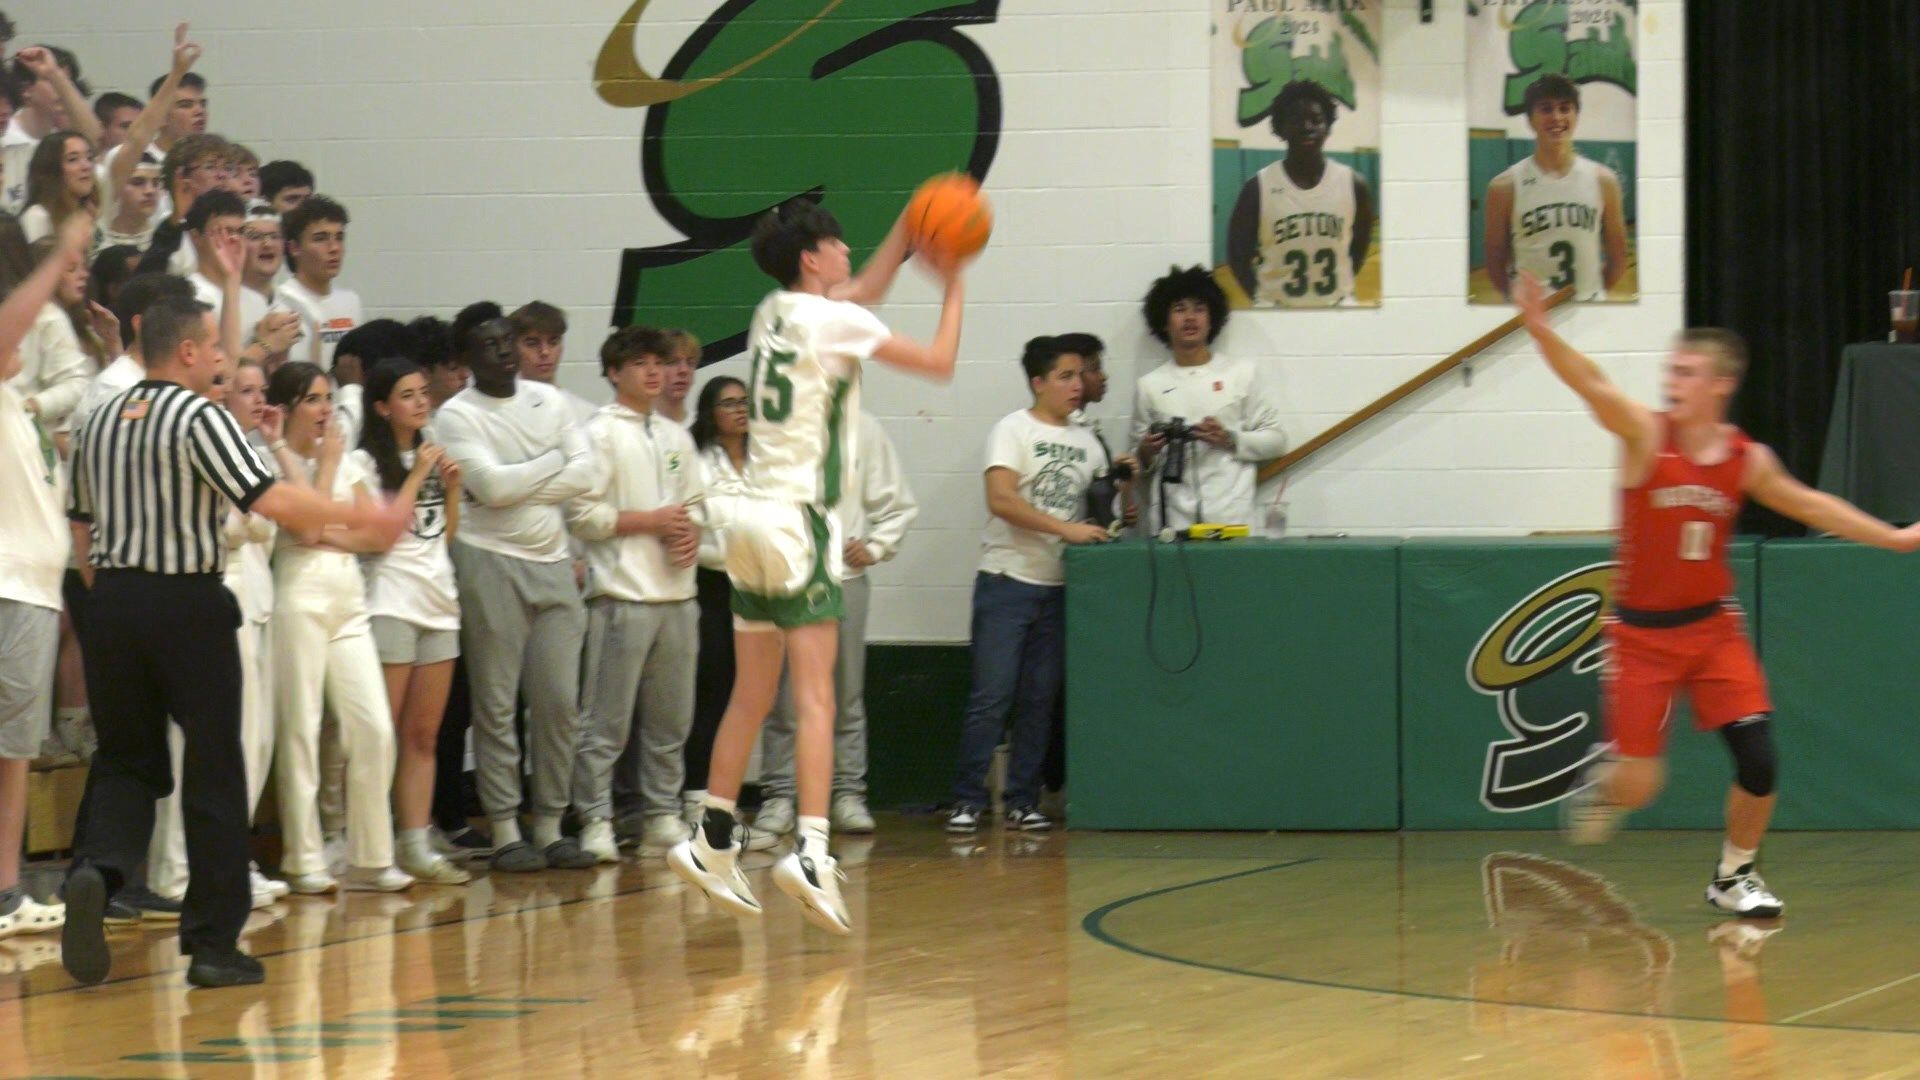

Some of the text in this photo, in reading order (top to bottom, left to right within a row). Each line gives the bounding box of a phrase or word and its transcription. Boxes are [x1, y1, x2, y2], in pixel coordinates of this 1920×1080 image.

[1274, 211, 1343, 244] SETON
[1521, 202, 1597, 236] SETON
[1283, 249, 1337, 297] 33
[1549, 240, 1575, 291] 3
[750, 346, 797, 424] 15
